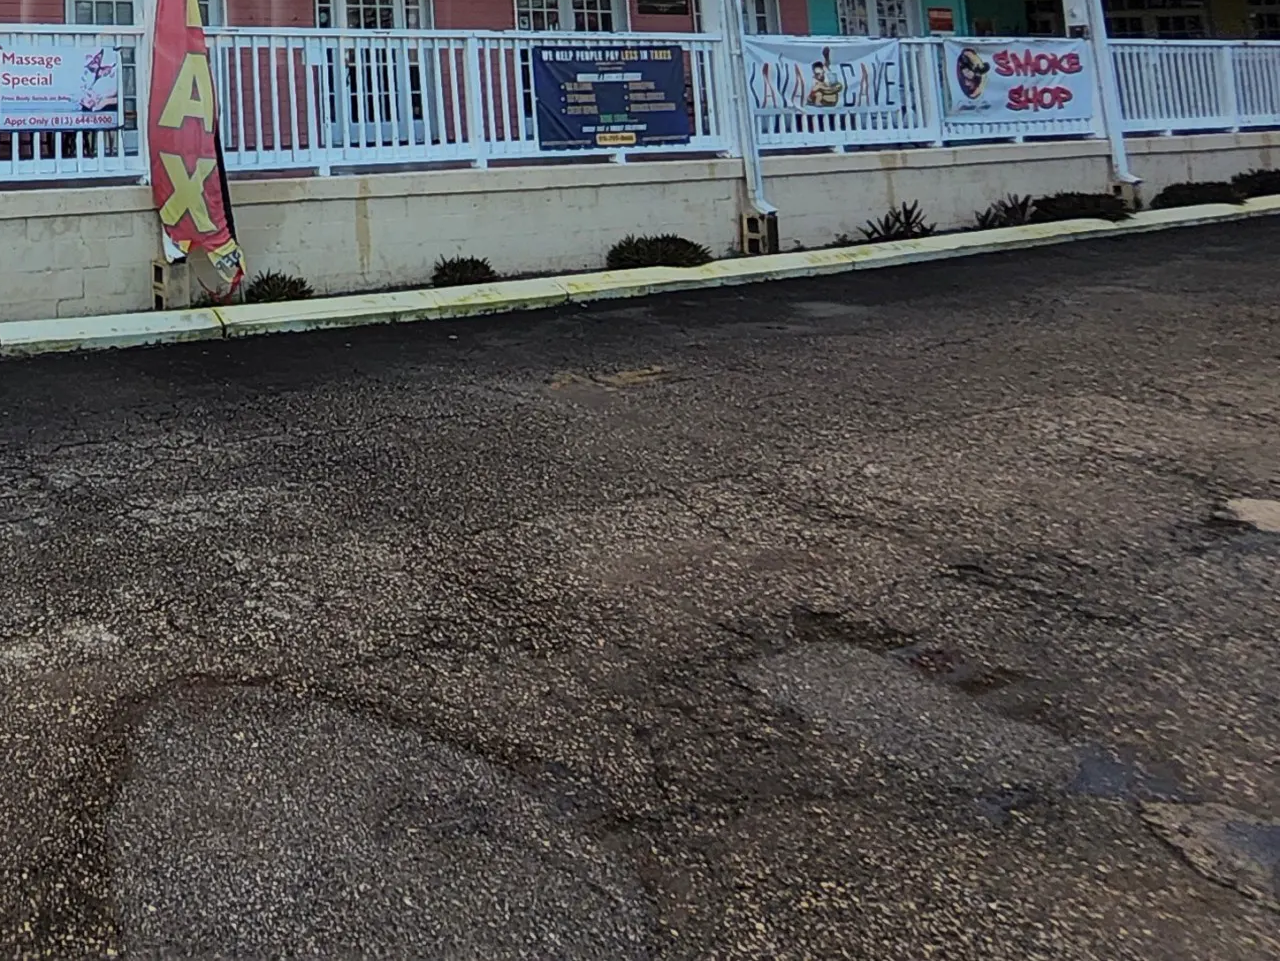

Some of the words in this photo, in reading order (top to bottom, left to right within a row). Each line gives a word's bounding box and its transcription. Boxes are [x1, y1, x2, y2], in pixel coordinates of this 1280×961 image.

[2, 52, 62, 70] Massage
[992, 49, 1083, 77] SMOKE
[1, 73, 53, 89] Special
[1005, 85, 1073, 112] SHOP
[4, 117, 26, 126] Appt
[28, 116, 49, 127] Only
[51, 115, 73, 126] (813)
[75, 115, 113, 125] 644-6900
